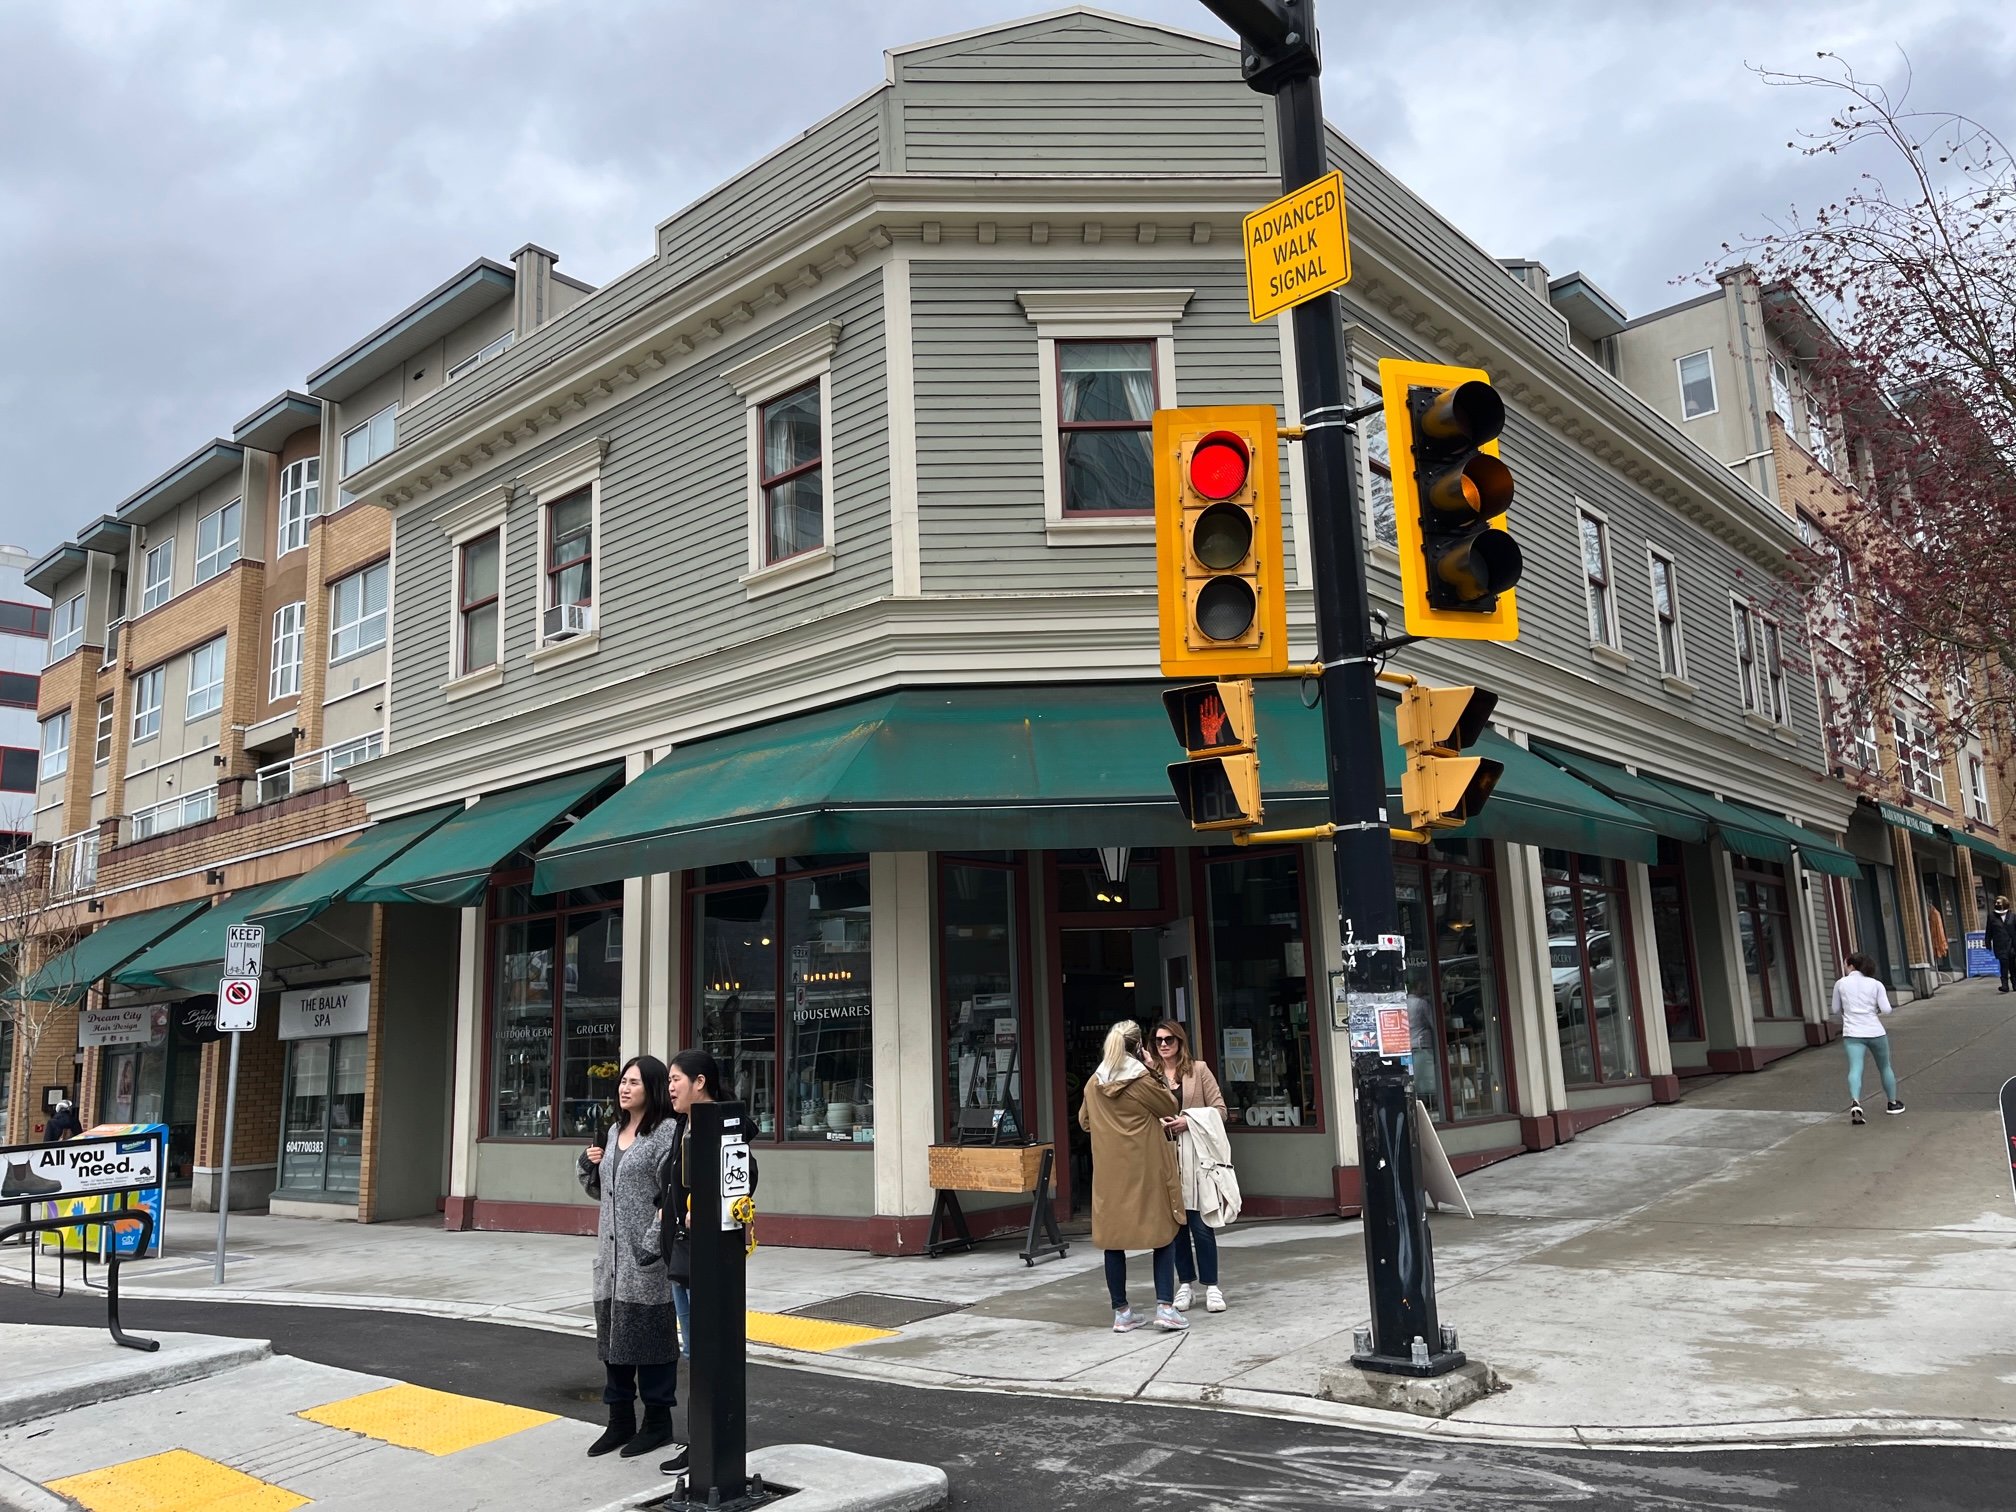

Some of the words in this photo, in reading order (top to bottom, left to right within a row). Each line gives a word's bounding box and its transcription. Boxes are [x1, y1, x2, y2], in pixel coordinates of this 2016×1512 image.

[1253, 190, 1335, 248] ADVANCED
[1273, 228, 1318, 266] WALK
[1269, 256, 1327, 297] SIGNAL
[231, 928, 261, 940] KEEP
[1551, 953, 1572, 963] OCERY
[301, 999, 317, 1012] THE
[318, 995, 348, 1011] BALAY
[88, 1013, 120, 1023] Dream
[123, 1010, 142, 1021] City
[181, 1009, 217, 1025] Bala
[314, 1014, 331, 1027] SPA
[793, 1005, 871, 1021] HOUSEWARES
[92, 1022, 111, 1032] Hair
[112, 1023, 138, 1032] Design
[496, 1025, 530, 1039] OUTDOOR
[532, 1027, 553, 1037] GEAR
[576, 1023, 616, 1035] GROCERY
[1246, 1106, 1300, 1126] OPEN
[286, 1141, 324, 1153] 6047700383
[40, 1149, 65, 1168] All
[69, 1150, 105, 1169] you
[78, 1157, 135, 1177] need.
